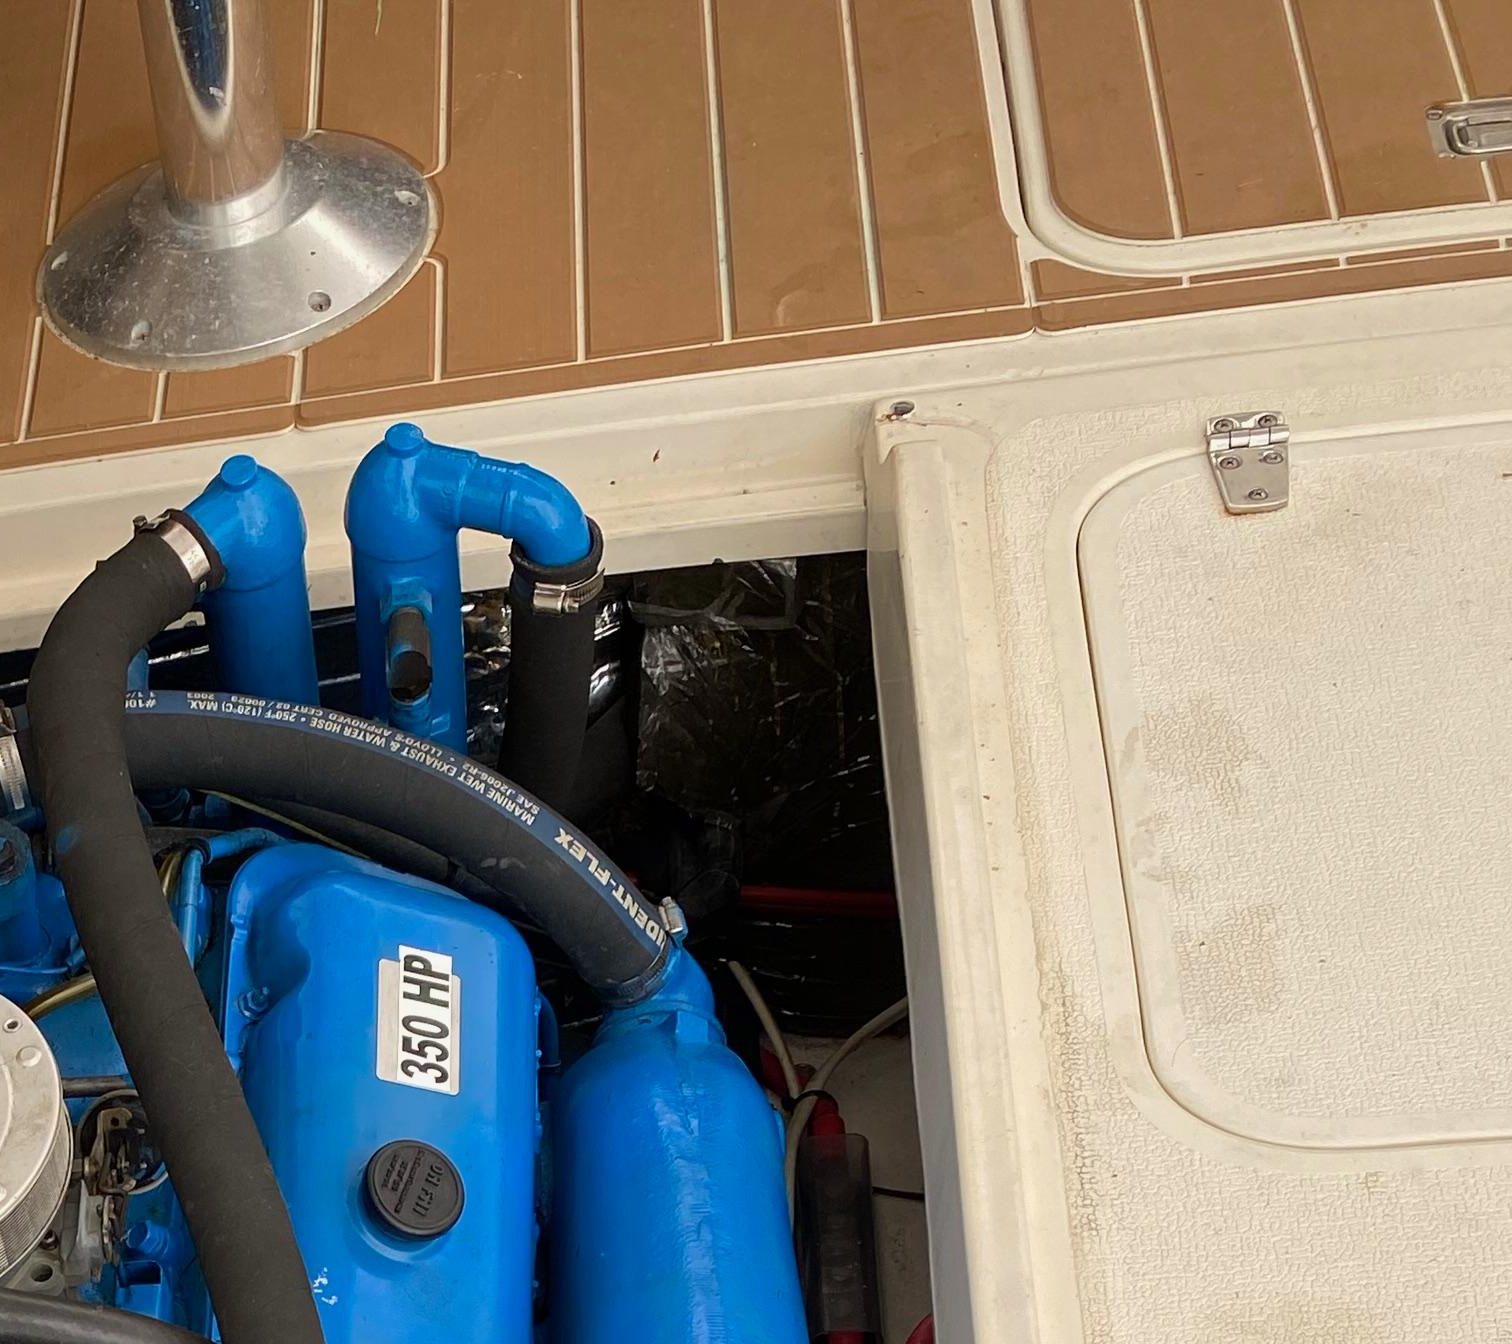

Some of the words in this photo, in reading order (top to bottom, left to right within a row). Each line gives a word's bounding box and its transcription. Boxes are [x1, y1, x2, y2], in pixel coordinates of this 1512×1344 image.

[292, 705, 324, 718] CERT
[310, 717, 342, 733] HOSE
[329, 712, 391, 737] APPROVED
[343, 727, 386, 748] WATER
[390, 740, 401, 753] &
[394, 734, 442, 757] LLOYD'S
[401, 743, 457, 777] EXHAUST
[457, 772, 486, 793] WET
[487, 785, 536, 826] MARINE
[517, 792, 540, 815] SAE
[403, 953, 449, 1008] HP
[402, 1015, 449, 1084] 350
